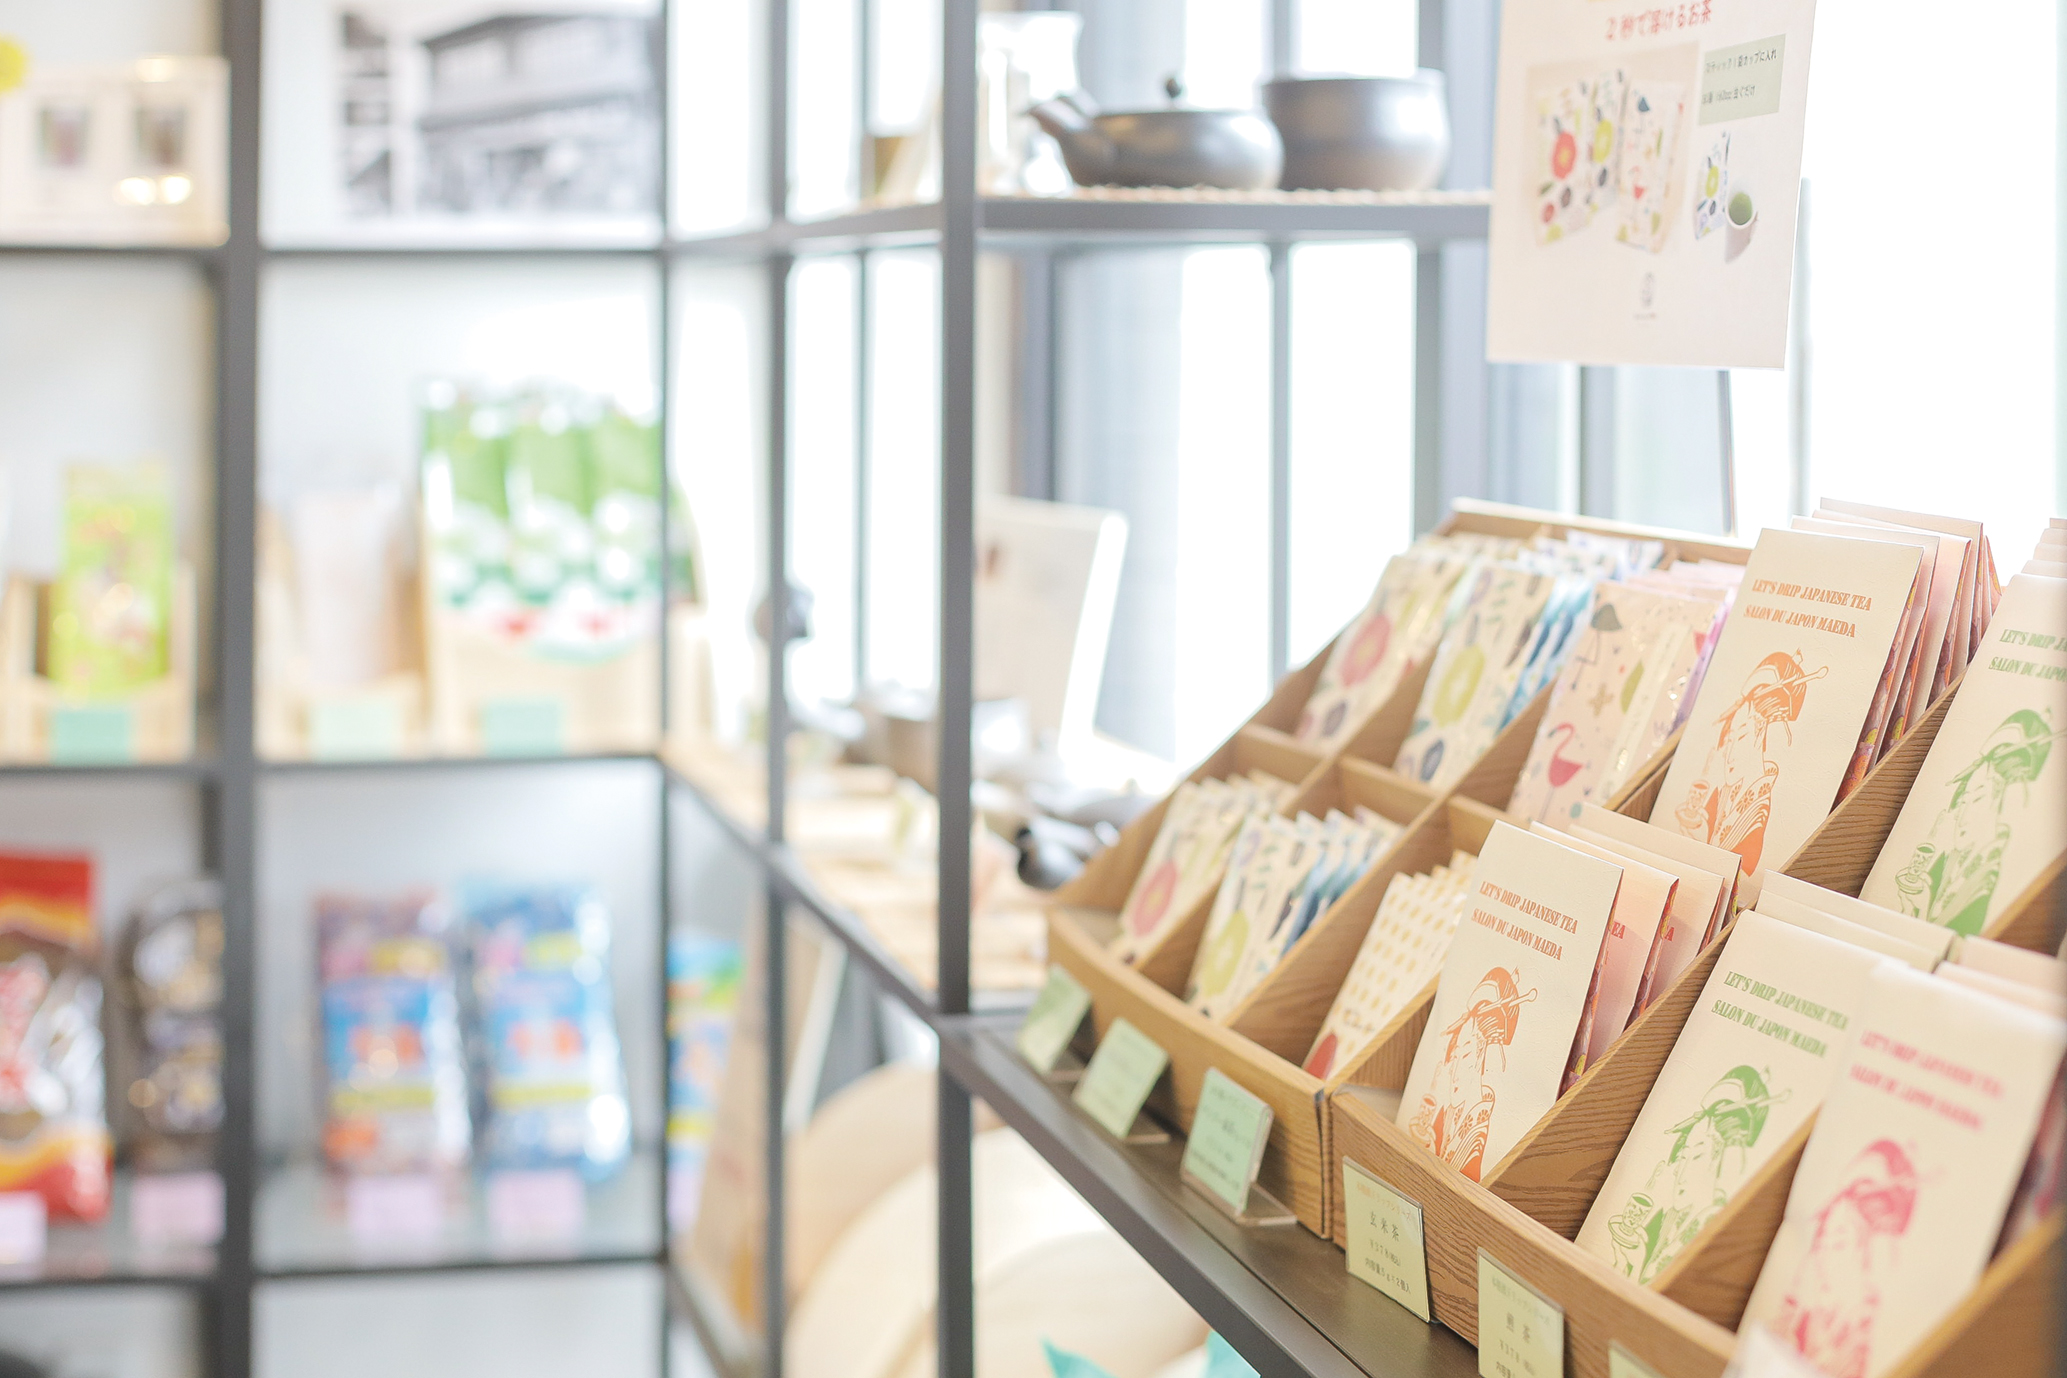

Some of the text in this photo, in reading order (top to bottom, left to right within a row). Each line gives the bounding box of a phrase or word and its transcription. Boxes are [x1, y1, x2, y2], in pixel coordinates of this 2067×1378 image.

[1752, 579, 1872, 611] LET'S DRIP JAPANESE TEA
[1744, 605, 1856, 637] SALON DU JAPON MAEDA
[1999, 629, 2029, 645] LET'S
[2027, 633, 2056, 649] DRIP
[1988, 656, 2067, 682] SALON DU JAPO
[1480, 881, 1578, 934] LET'S DRIP JAPANESE TEA
[1471, 908, 1562, 960] SALON DU JAPON MAEDA
[1611, 921, 1626, 940] EA
[1724, 971, 1752, 992] LET'S
[1750, 981, 1777, 1001] DRIP
[1774, 991, 1827, 1021] JAPANESE
[1711, 999, 1745, 1022] SALON
[1742, 1011, 1760, 1029] DU
[1757, 1018, 1792, 1041] JAPON
